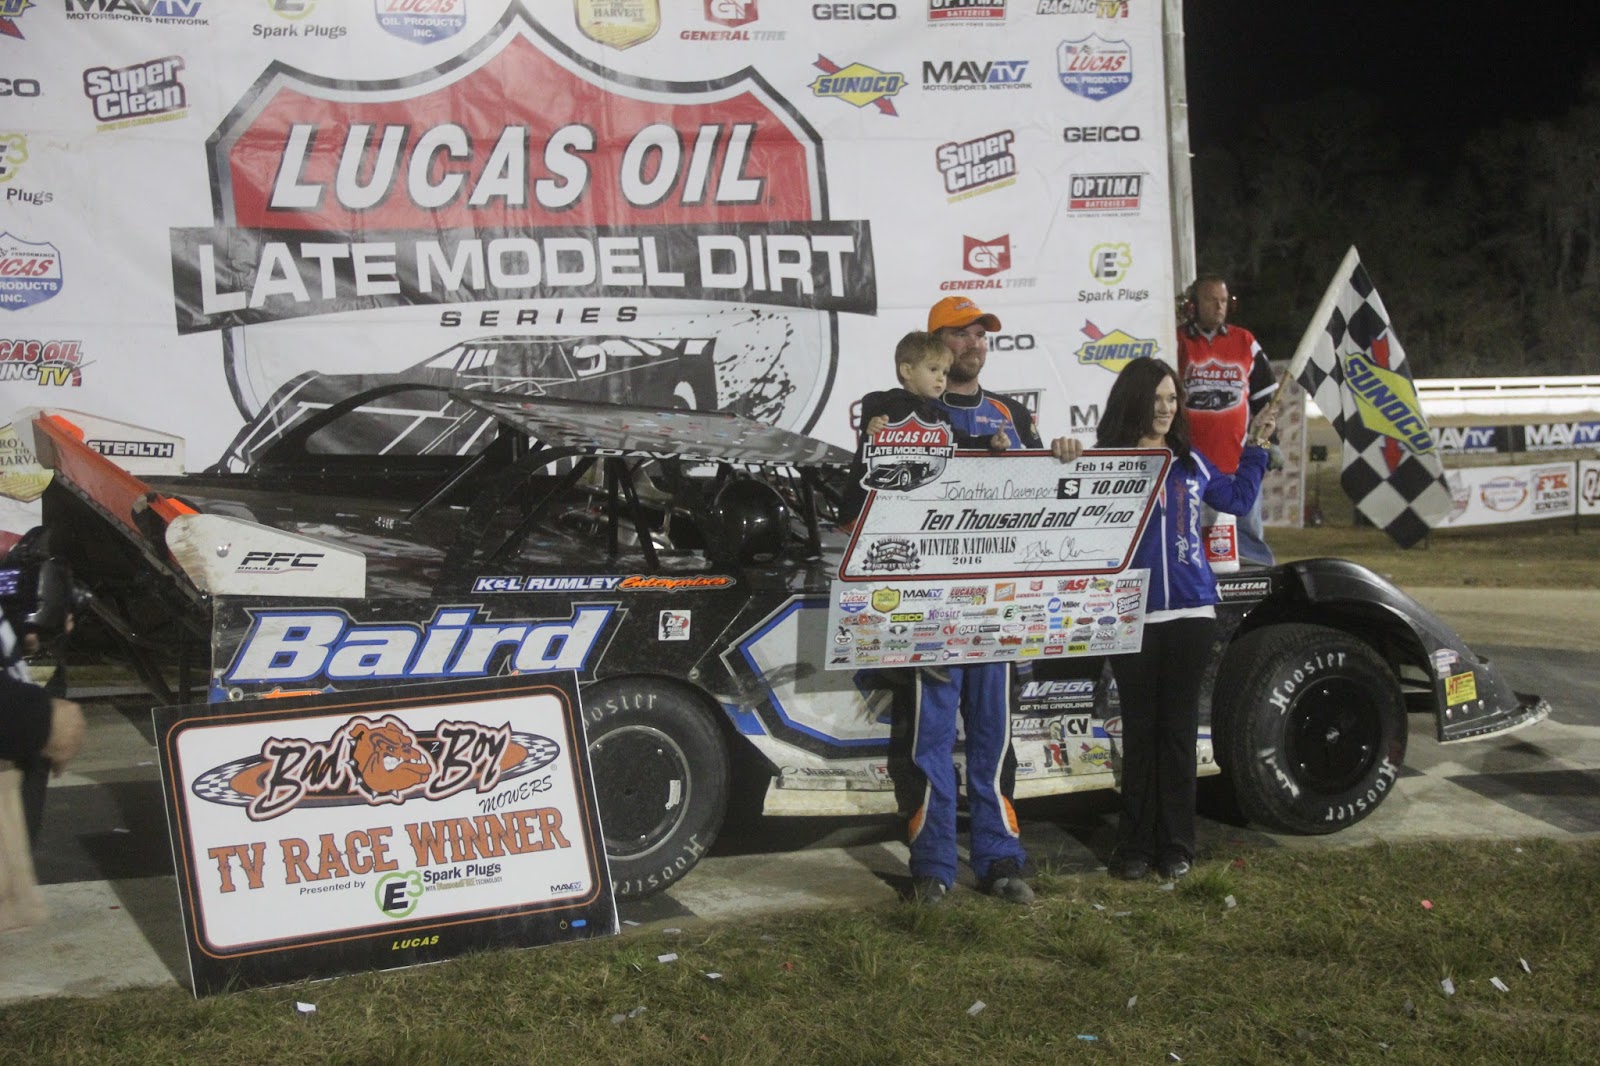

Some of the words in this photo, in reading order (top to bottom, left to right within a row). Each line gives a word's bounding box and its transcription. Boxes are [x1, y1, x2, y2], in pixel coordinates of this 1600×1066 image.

[593, 7, 645, 18] HARVEST
[812, 4, 896, 21] GEICO
[946, 9, 992, 18] BATTERIES
[1036, 0, 1096, 15] RACING
[66, 12, 153, 23] MOTORSPORTS
[156, 17, 210, 26] NETWORK
[382, 17, 400, 26] OIL
[404, 17, 462, 27] PRODUCTS
[252, 24, 298, 38] Spark
[304, 24, 347, 39] Plugs
[413, 28, 435, 38] INC.
[680, 30, 749, 41] GENERAL
[753, 31, 786, 41] TIRE
[1067, 55, 1126, 72] LUCAS
[86, 58, 183, 96] Super
[922, 61, 1030, 84] MAVTV
[1063, 76, 1078, 84] OIL
[1081, 75, 1129, 84] PRODUCTS
[817, 76, 901, 94] SUNOCO
[1087, 87, 1108, 95] INC.
[96, 85, 183, 120] Clean
[1063, 125, 1141, 143] GEICO
[938, 132, 1013, 169] Super
[269, 122, 595, 210] LUCAS
[619, 121, 767, 207] OIL
[944, 154, 1015, 189] Clean
[1072, 175, 1139, 198] OPTIMA
[7, 188, 53, 205] Plugs
[199, 240, 399, 315] LATE
[416, 236, 687, 295] MODEL
[699, 234, 855, 298] DIRT
[0, 281, 57, 291] RODUCTS
[940, 279, 1002, 291] GENERAL
[1004, 277, 1036, 288] TIRE
[1, 294, 26, 303] INC.
[1078, 290, 1114, 303] Spark
[1117, 288, 1149, 301] Plugs
[440, 306, 638, 328] SERIES
[989, 334, 1036, 352] ICO
[1082, 341, 1152, 361] SUNOCO
[0, 341, 40, 363] CAS
[42, 340, 82, 364] OIL
[0, 362, 37, 380] ING
[38, 366, 71, 386] TV
[1192, 368, 1220, 378] LUCAS
[1223, 370, 1238, 379] OIL
[1345, 357, 1435, 452] SUNOCO
[878, 431, 920, 444] LUCAS
[921, 431, 942, 443] OIL
[1524, 422, 1600, 447] MAVTV
[87, 439, 174, 458] STEALTH
[867, 446, 892, 456] LATE
[893, 446, 928, 455] MODEL
[929, 446, 952, 456] DIRT
[1075, 460, 1096, 472] Feb
[1097, 460, 1114, 472] 14
[1118, 460, 1147, 472] 2016
[937, 480, 998, 501] Jonathan
[1003, 481, 1059, 501] Davenport
[1064, 479, 1079, 496] $
[1090, 479, 1147, 495] 10,000
[1537, 474, 1568, 491] FK
[920, 508, 953, 531] Ten
[954, 507, 1045, 530] Thousand
[1046, 506, 1081, 528] and
[920, 538, 959, 556] WINTER
[961, 536, 1016, 556] NATIONALS
[240, 552, 325, 567] PFC
[952, 556, 982, 565] 2016
[476, 577, 523, 591] K&L
[525, 577, 621, 591] RUMLEY
[619, 574, 728, 589] Enterprises
[950, 587, 973, 596] LUCAS
[974, 586, 989, 595] OIL
[1116, 579, 1142, 588] OPTIMA
[1222, 582, 1268, 591] ALLSTAR
[903, 588, 943, 598] MAVTV
[891, 613, 923, 622] GEICO
[927, 608, 961, 620] Hoosier
[222, 605, 615, 684] Baird
[1269, 651, 1346, 716] Hoosier
[583, 693, 657, 731] osier
[1049, 702, 1094, 710] CAROLINAS
[1067, 717, 1089, 735] CV
[429, 727, 507, 794] Boy
[252, 737, 344, 819] Bad
[479, 775, 553, 813] MOWERS
[1325, 757, 1397, 822] Hoosier
[208, 841, 268, 893] TV
[279, 826, 399, 885] RACE
[405, 806, 571, 868] WINNER
[423, 867, 462, 884] Spark
[466, 863, 502, 878] Plugs
[475, 877, 503, 886] TECHNOLOGY
[299, 882, 351, 896] Presented
[353, 880, 366, 891] by
[550, 881, 582, 893] MAVTV
[391, 934, 440, 951] LUCAS
